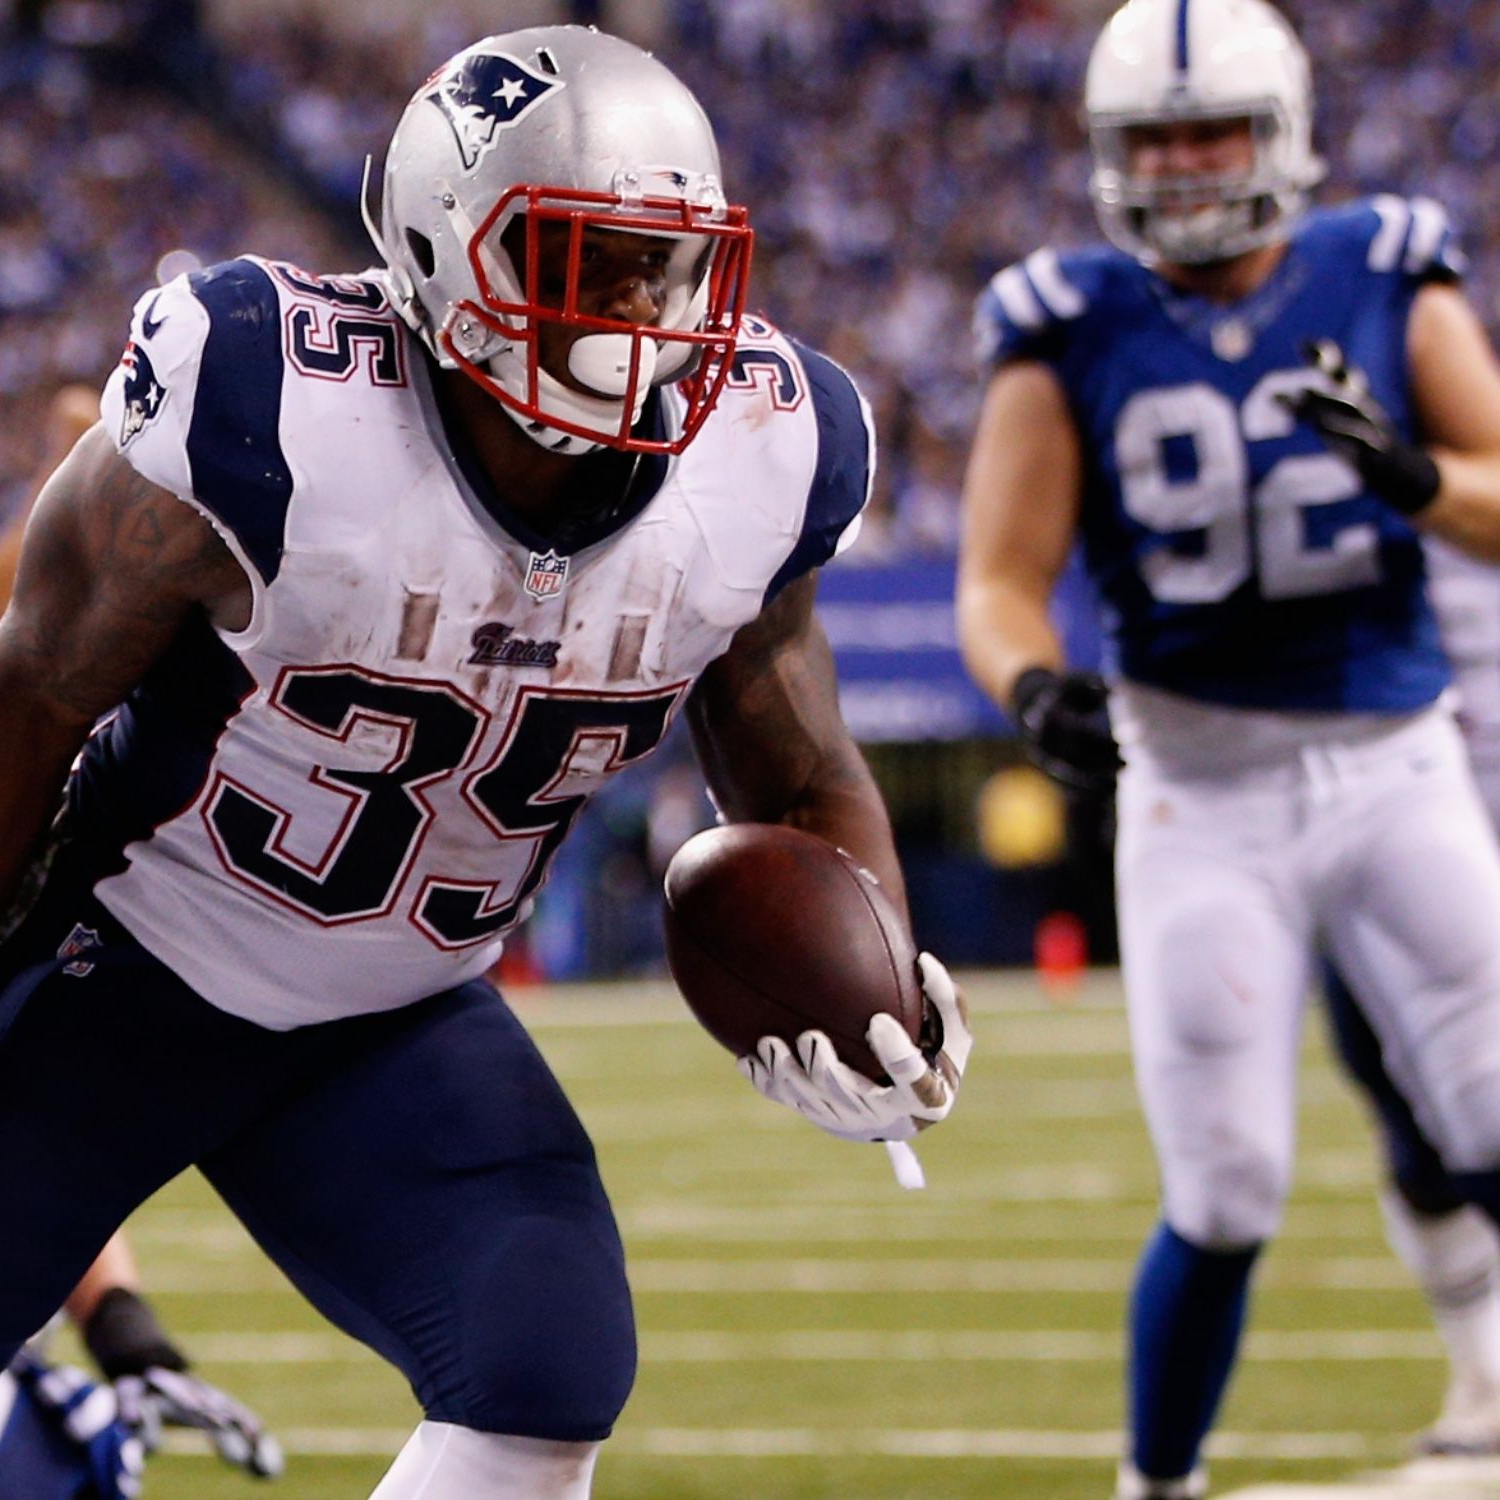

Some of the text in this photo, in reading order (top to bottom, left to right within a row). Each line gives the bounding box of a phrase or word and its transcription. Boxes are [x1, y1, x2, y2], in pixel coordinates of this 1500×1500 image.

[265, 261, 408, 388] 35
[1114, 366, 1380, 603] 92
[467, 622, 562, 668] Patriots
[200, 663, 692, 951] 35
